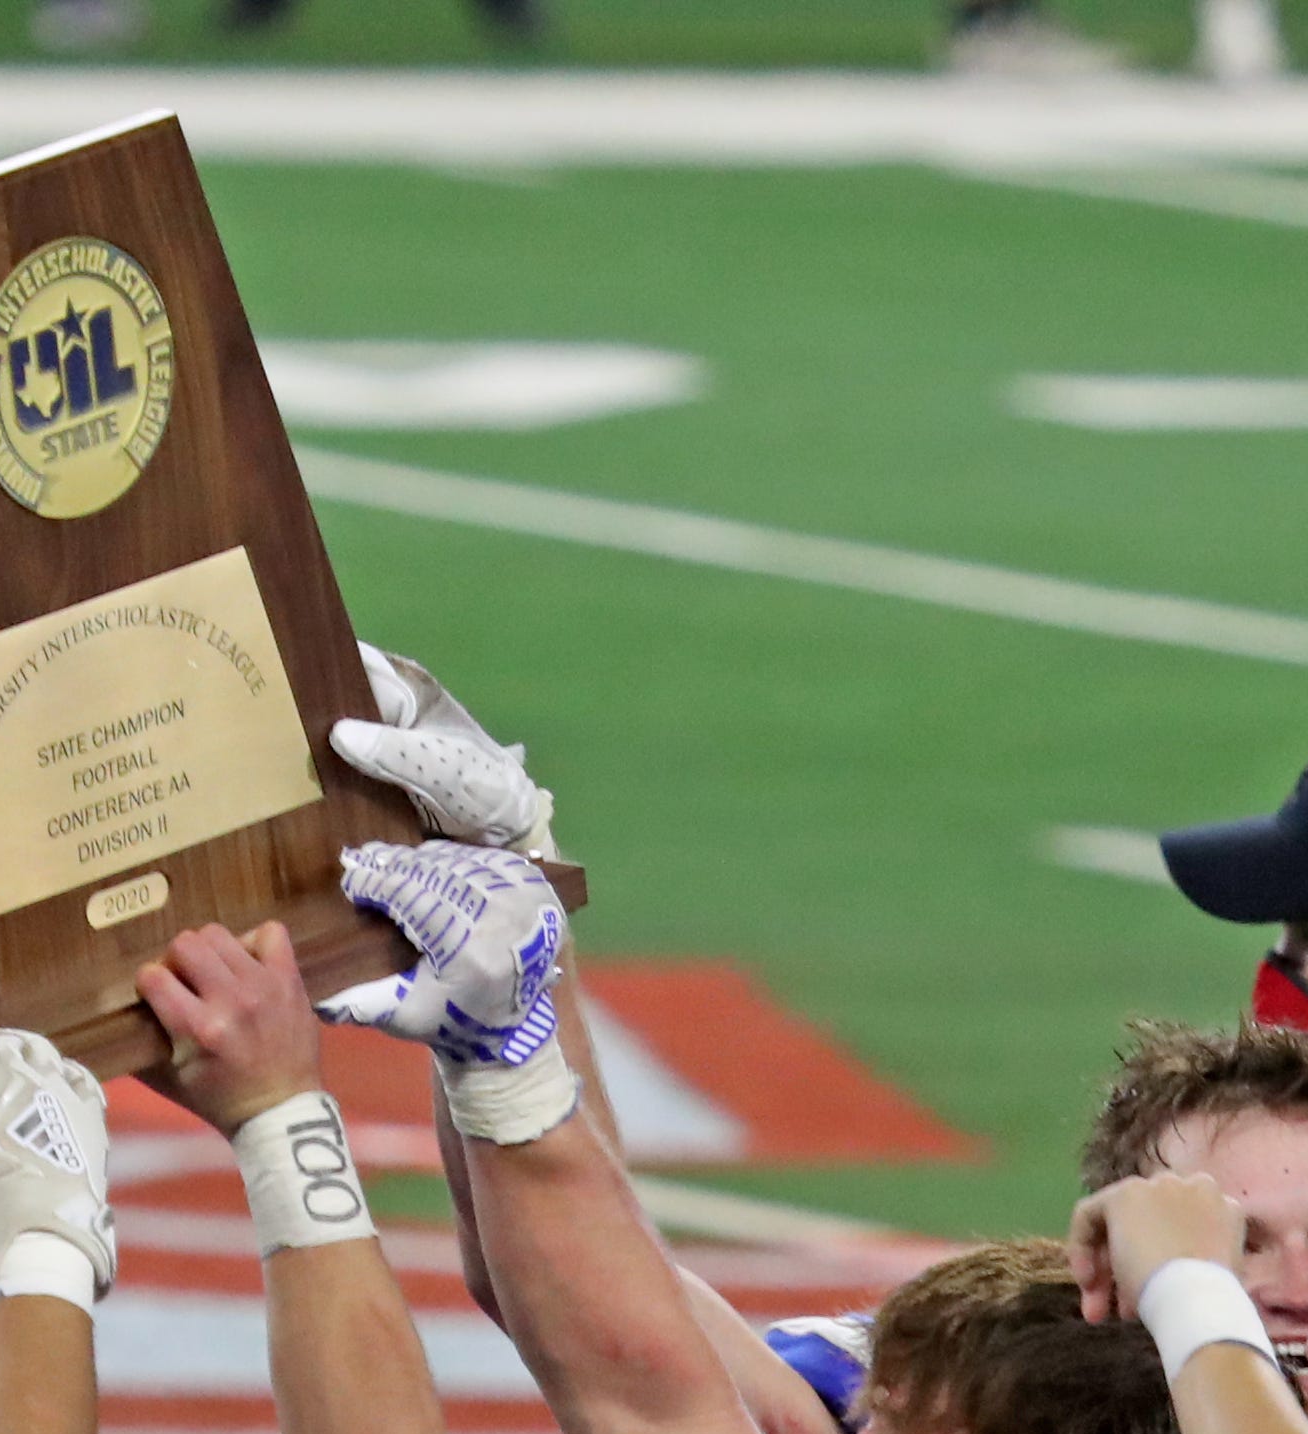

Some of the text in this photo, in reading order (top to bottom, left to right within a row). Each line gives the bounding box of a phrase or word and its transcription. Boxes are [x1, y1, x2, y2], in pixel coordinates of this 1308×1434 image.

[8, 306, 138, 435] UIL
[42, 411, 120, 464] STATE
[43, 604, 206, 662] INTERSCHOLASTIC
[206, 625, 268, 698] LEAGUE
[37, 697, 186, 769] STATE CHAMPION
[71, 746, 159, 793] FOOTBALL
[46, 771, 192, 840] CONFERENCE AA
[77, 814, 169, 864] DIVISION II
[102, 883, 151, 919] 2020
